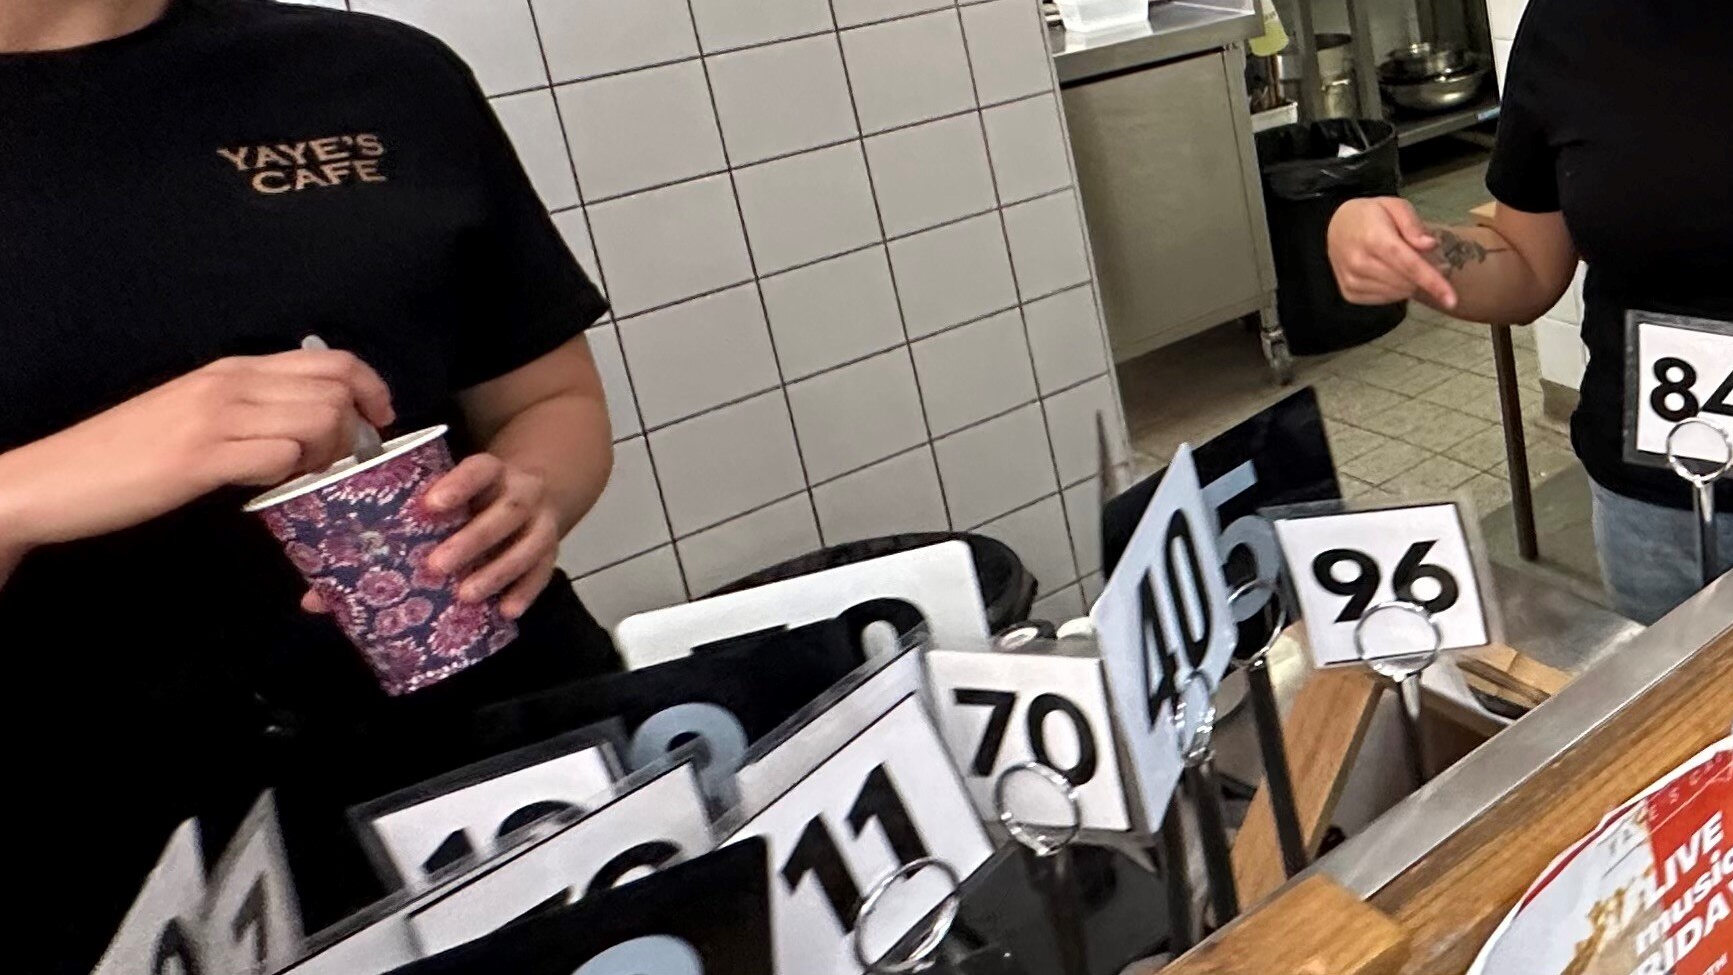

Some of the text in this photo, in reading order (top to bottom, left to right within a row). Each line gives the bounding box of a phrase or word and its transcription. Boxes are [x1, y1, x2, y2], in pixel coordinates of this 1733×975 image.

[215, 132, 386, 171] YAYE'S
[251, 159, 388, 195] CAFE
[1138, 507, 1213, 733] 40
[1311, 539, 1460, 623] 96
[951, 687, 1098, 787] 70
[782, 763, 931, 934] 11
[1642, 810, 1725, 909] LIVE
